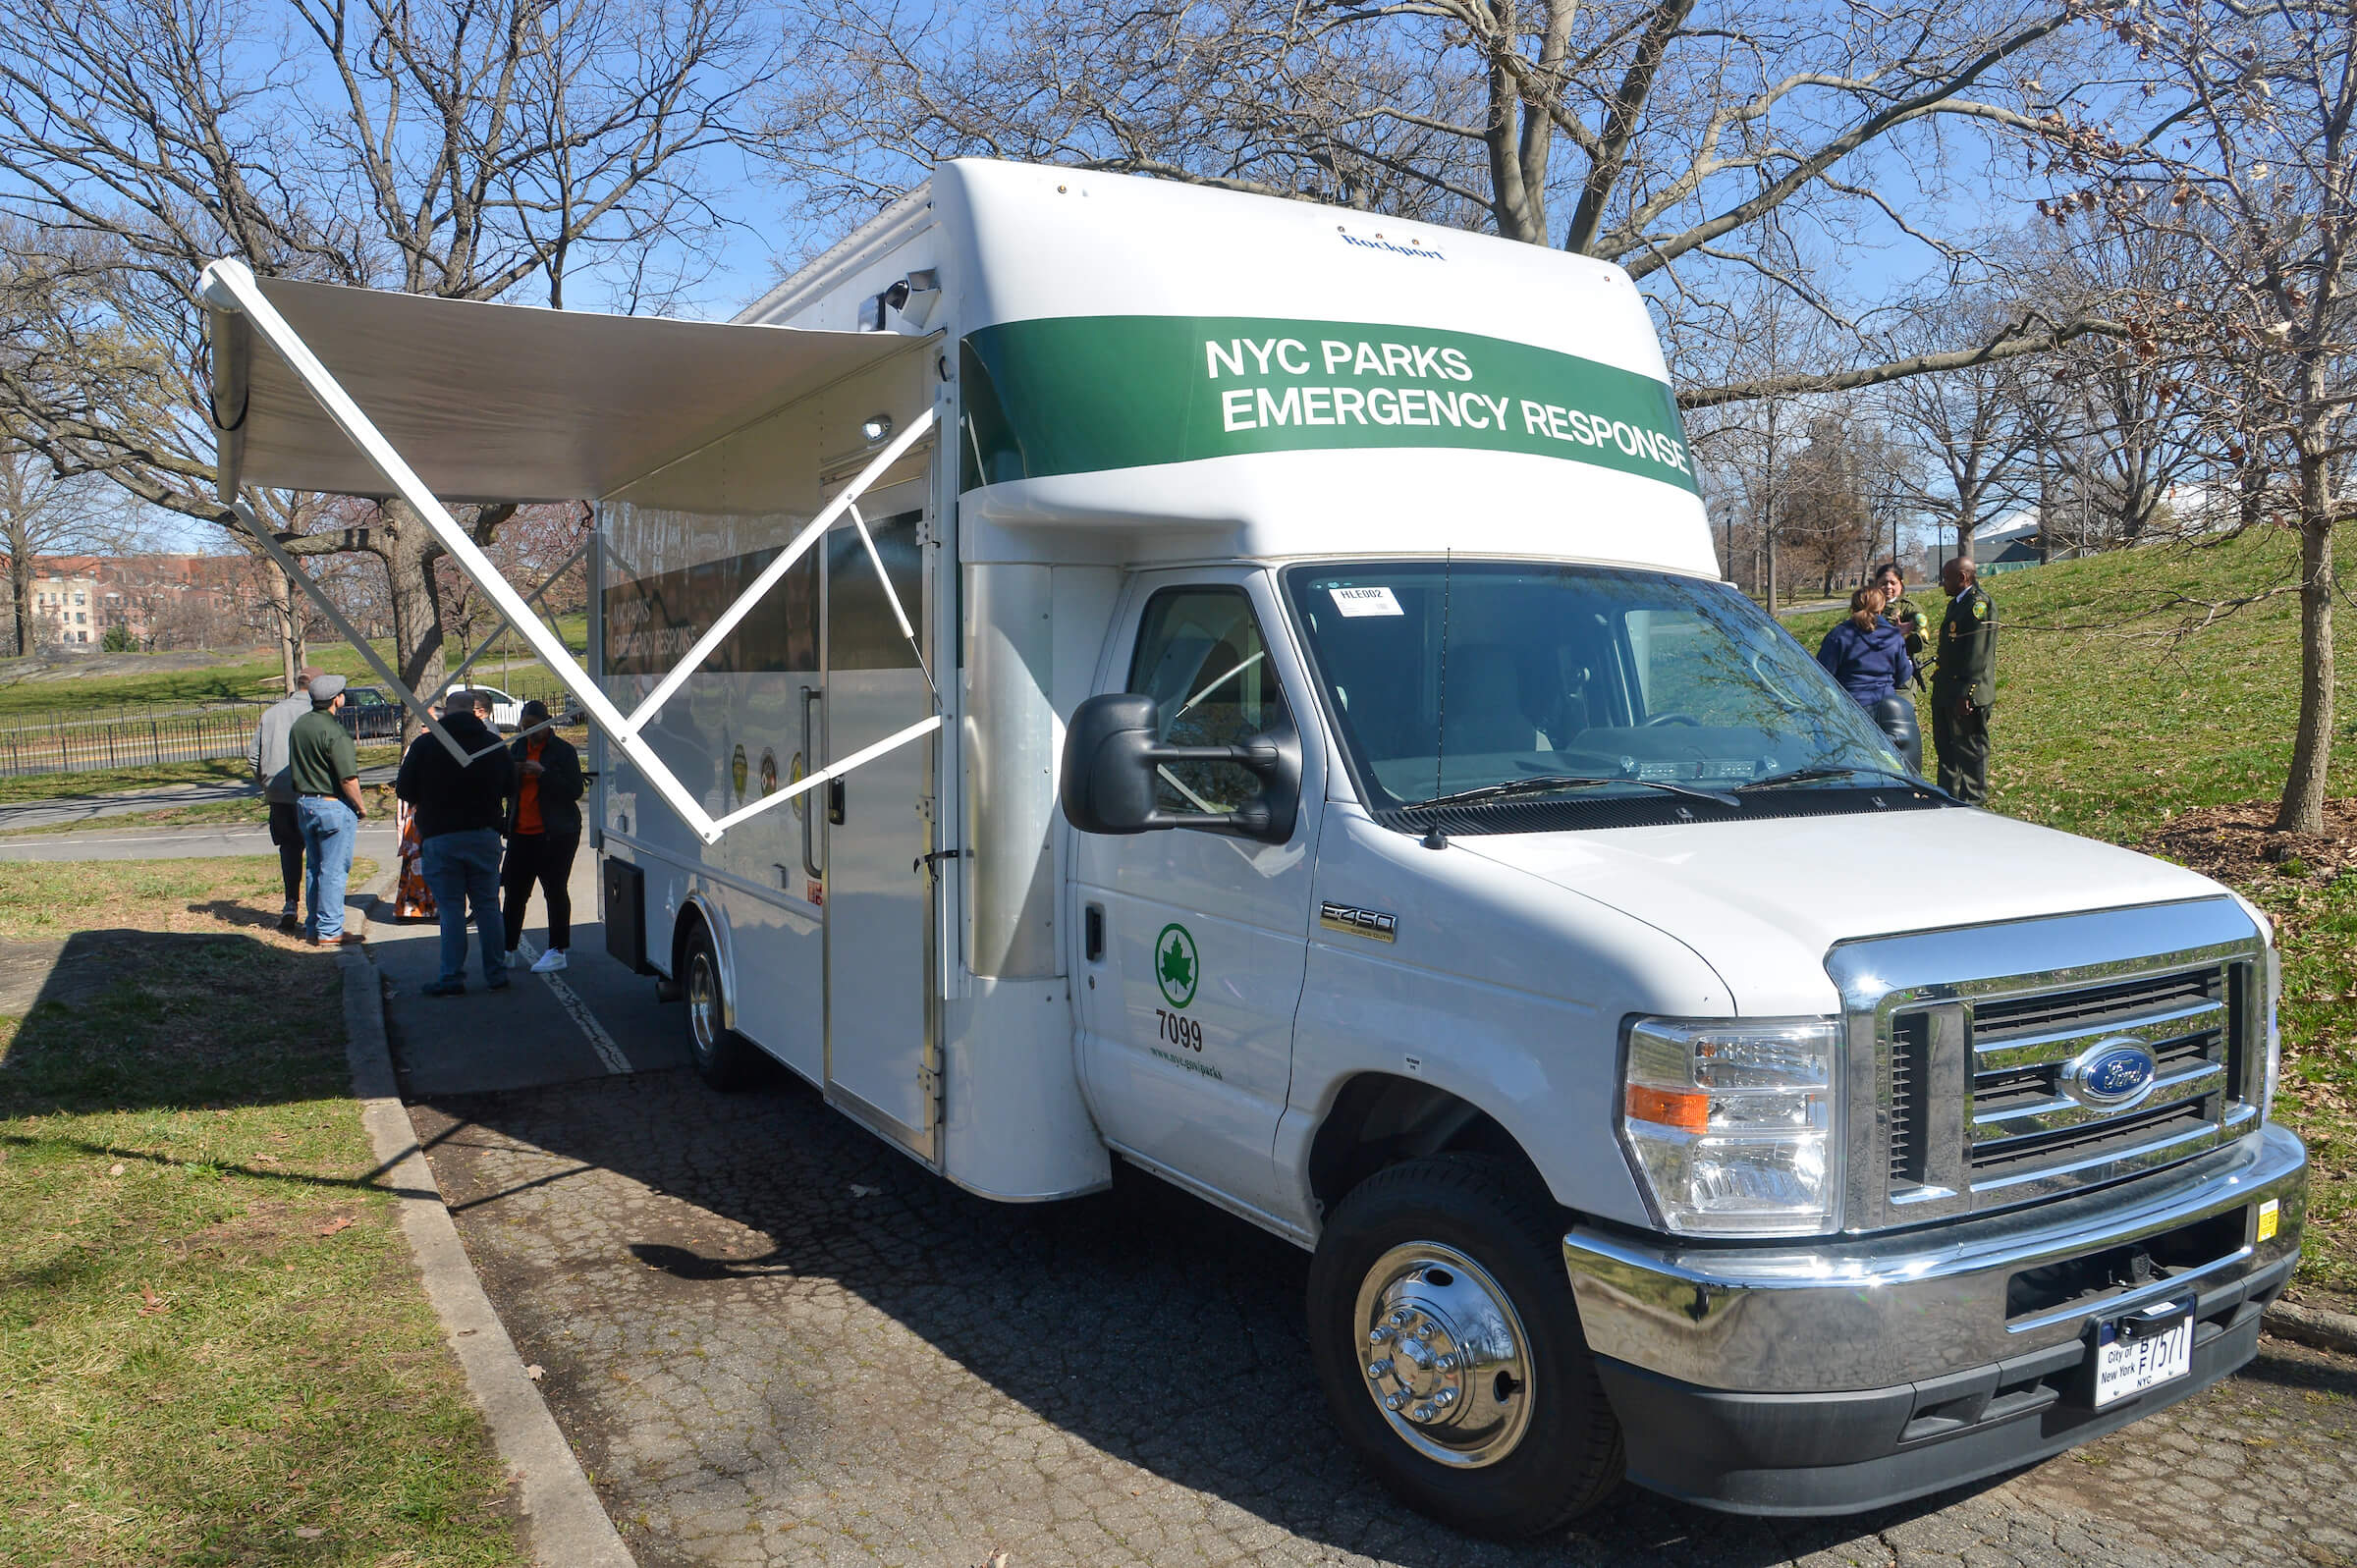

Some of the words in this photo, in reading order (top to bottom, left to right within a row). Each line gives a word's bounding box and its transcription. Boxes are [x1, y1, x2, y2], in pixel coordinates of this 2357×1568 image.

[1340, 234, 1447, 261] Rockport
[1205, 338, 1310, 379] NYC
[1320, 339, 1473, 382] PARKS
[1222, 387, 1509, 433] EMERGENCY
[1521, 399, 1691, 476] RESPONSE
[1156, 1008, 1202, 1053] 7099
[2104, 1058, 2143, 1089] Ford
[2108, 1350, 2123, 1364] City
[2101, 1370, 2117, 1384] New
[2119, 1362, 2135, 1378] York
[2136, 1376, 2152, 1387] NYC
